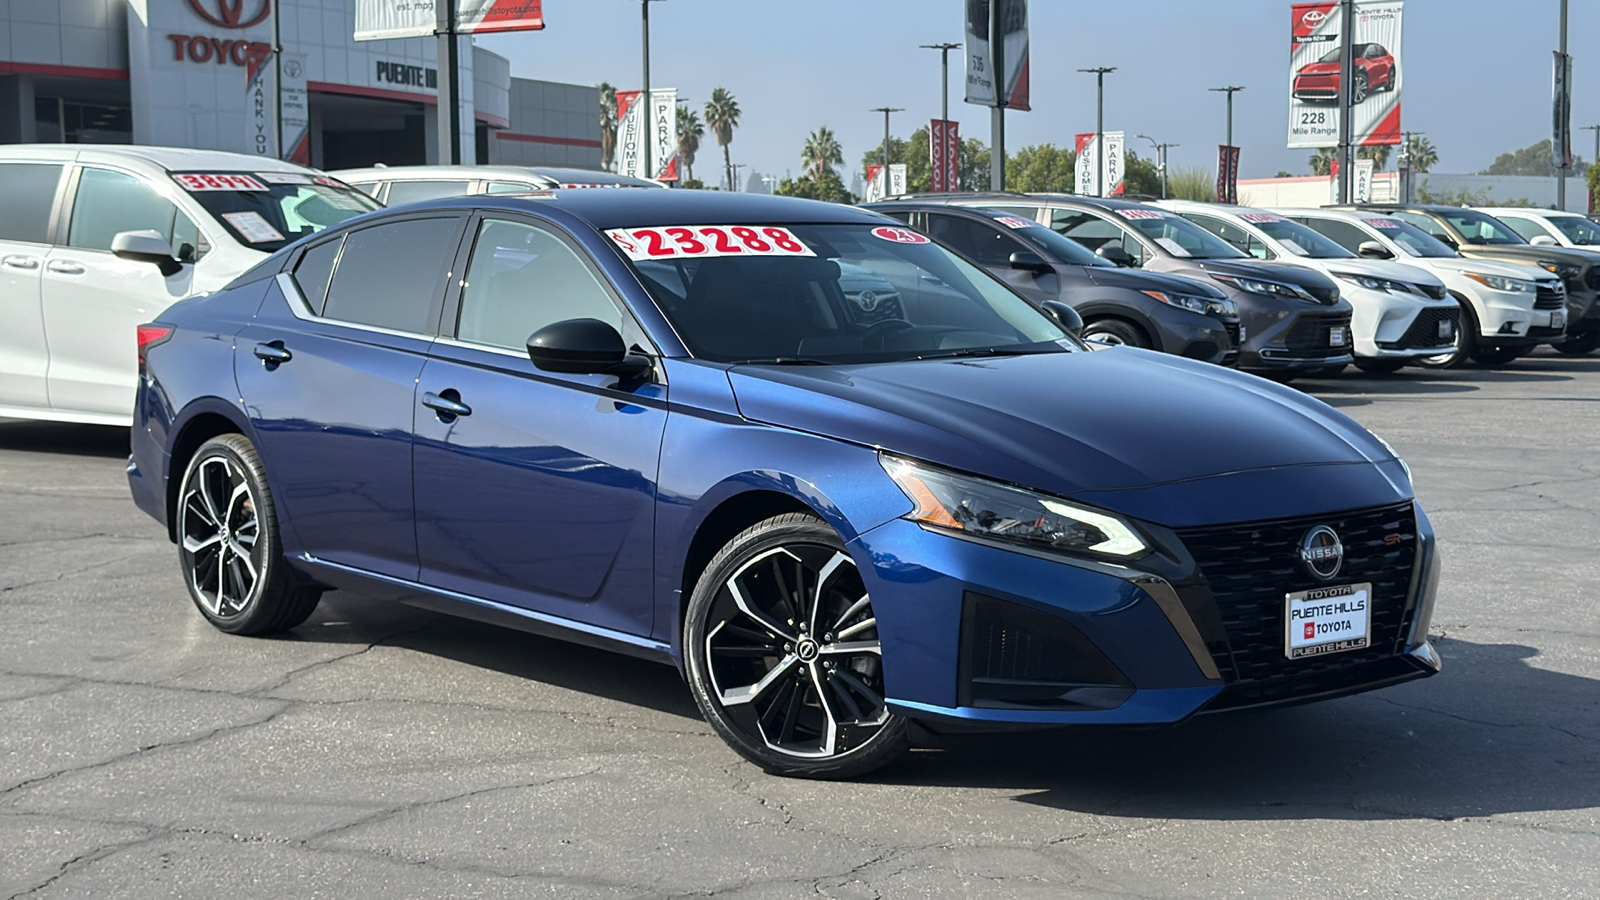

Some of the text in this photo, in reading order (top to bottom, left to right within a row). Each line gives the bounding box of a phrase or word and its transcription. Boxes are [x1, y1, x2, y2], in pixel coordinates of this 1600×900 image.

[396, 2, 434, 13] est. mpg
[167, 34, 268, 66] TOYO
[377, 61, 424, 87] PUENTE
[1301, 112, 1325, 124] 228
[255, 124, 266, 154] YOU
[626, 106, 636, 177] CUSTOMER
[658, 105, 669, 177] PARKING
[1292, 126, 1337, 137] Mile Range
[933, 125, 941, 191] TOYOTA
[948, 126, 956, 192] TOYOTA
[612, 228, 806, 256] $23288
[1384, 533, 1401, 546] SR
[1308, 586, 1351, 599] TOYOTA
[1291, 600, 1365, 620] PUENTE HILLS
[1316, 620, 1352, 635] TOYOTA
[1293, 638, 1366, 657] PUENTE HILLS
